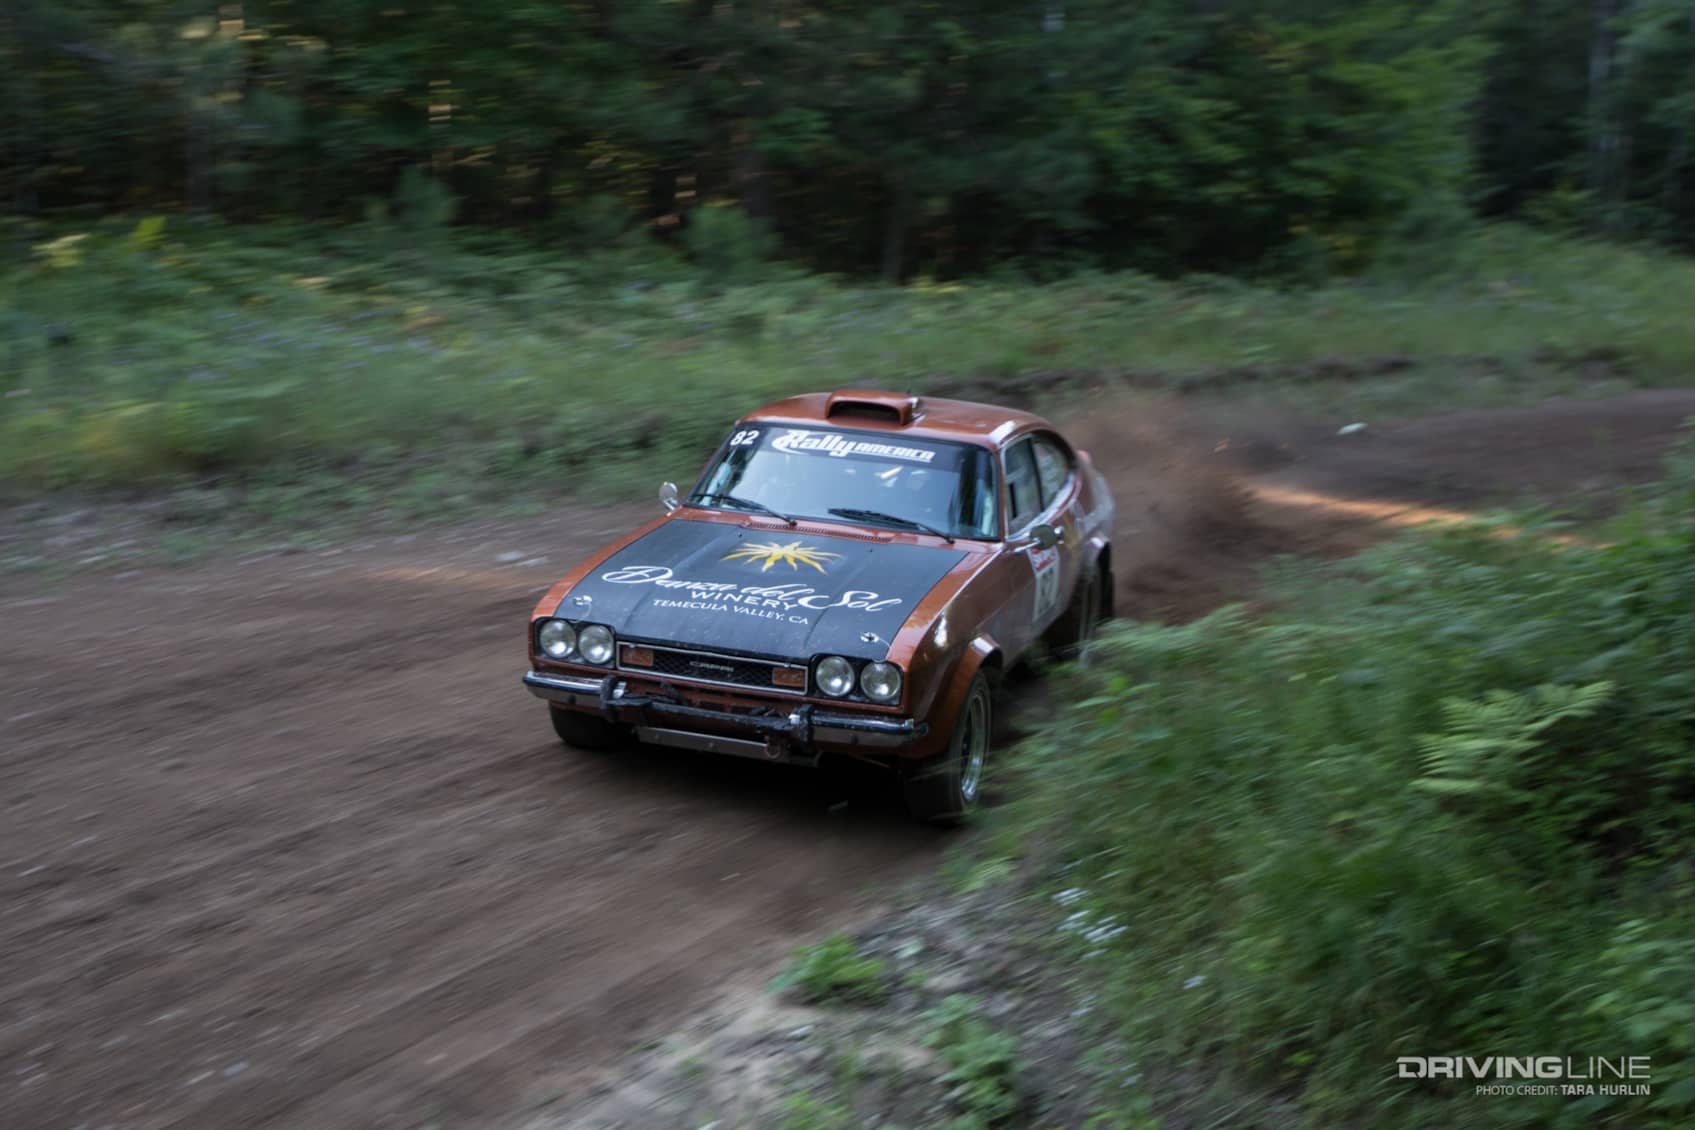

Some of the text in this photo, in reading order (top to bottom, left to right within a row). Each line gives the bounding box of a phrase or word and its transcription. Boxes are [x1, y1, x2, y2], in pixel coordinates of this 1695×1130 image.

[729, 430, 760, 446] 82
[772, 429, 853, 458] Rally
[691, 591, 798, 611] WINERY
[741, 583, 815, 601] del
[798, 590, 902, 612] Sol
[653, 599, 809, 625] TEMECULA VALLEY, CA
